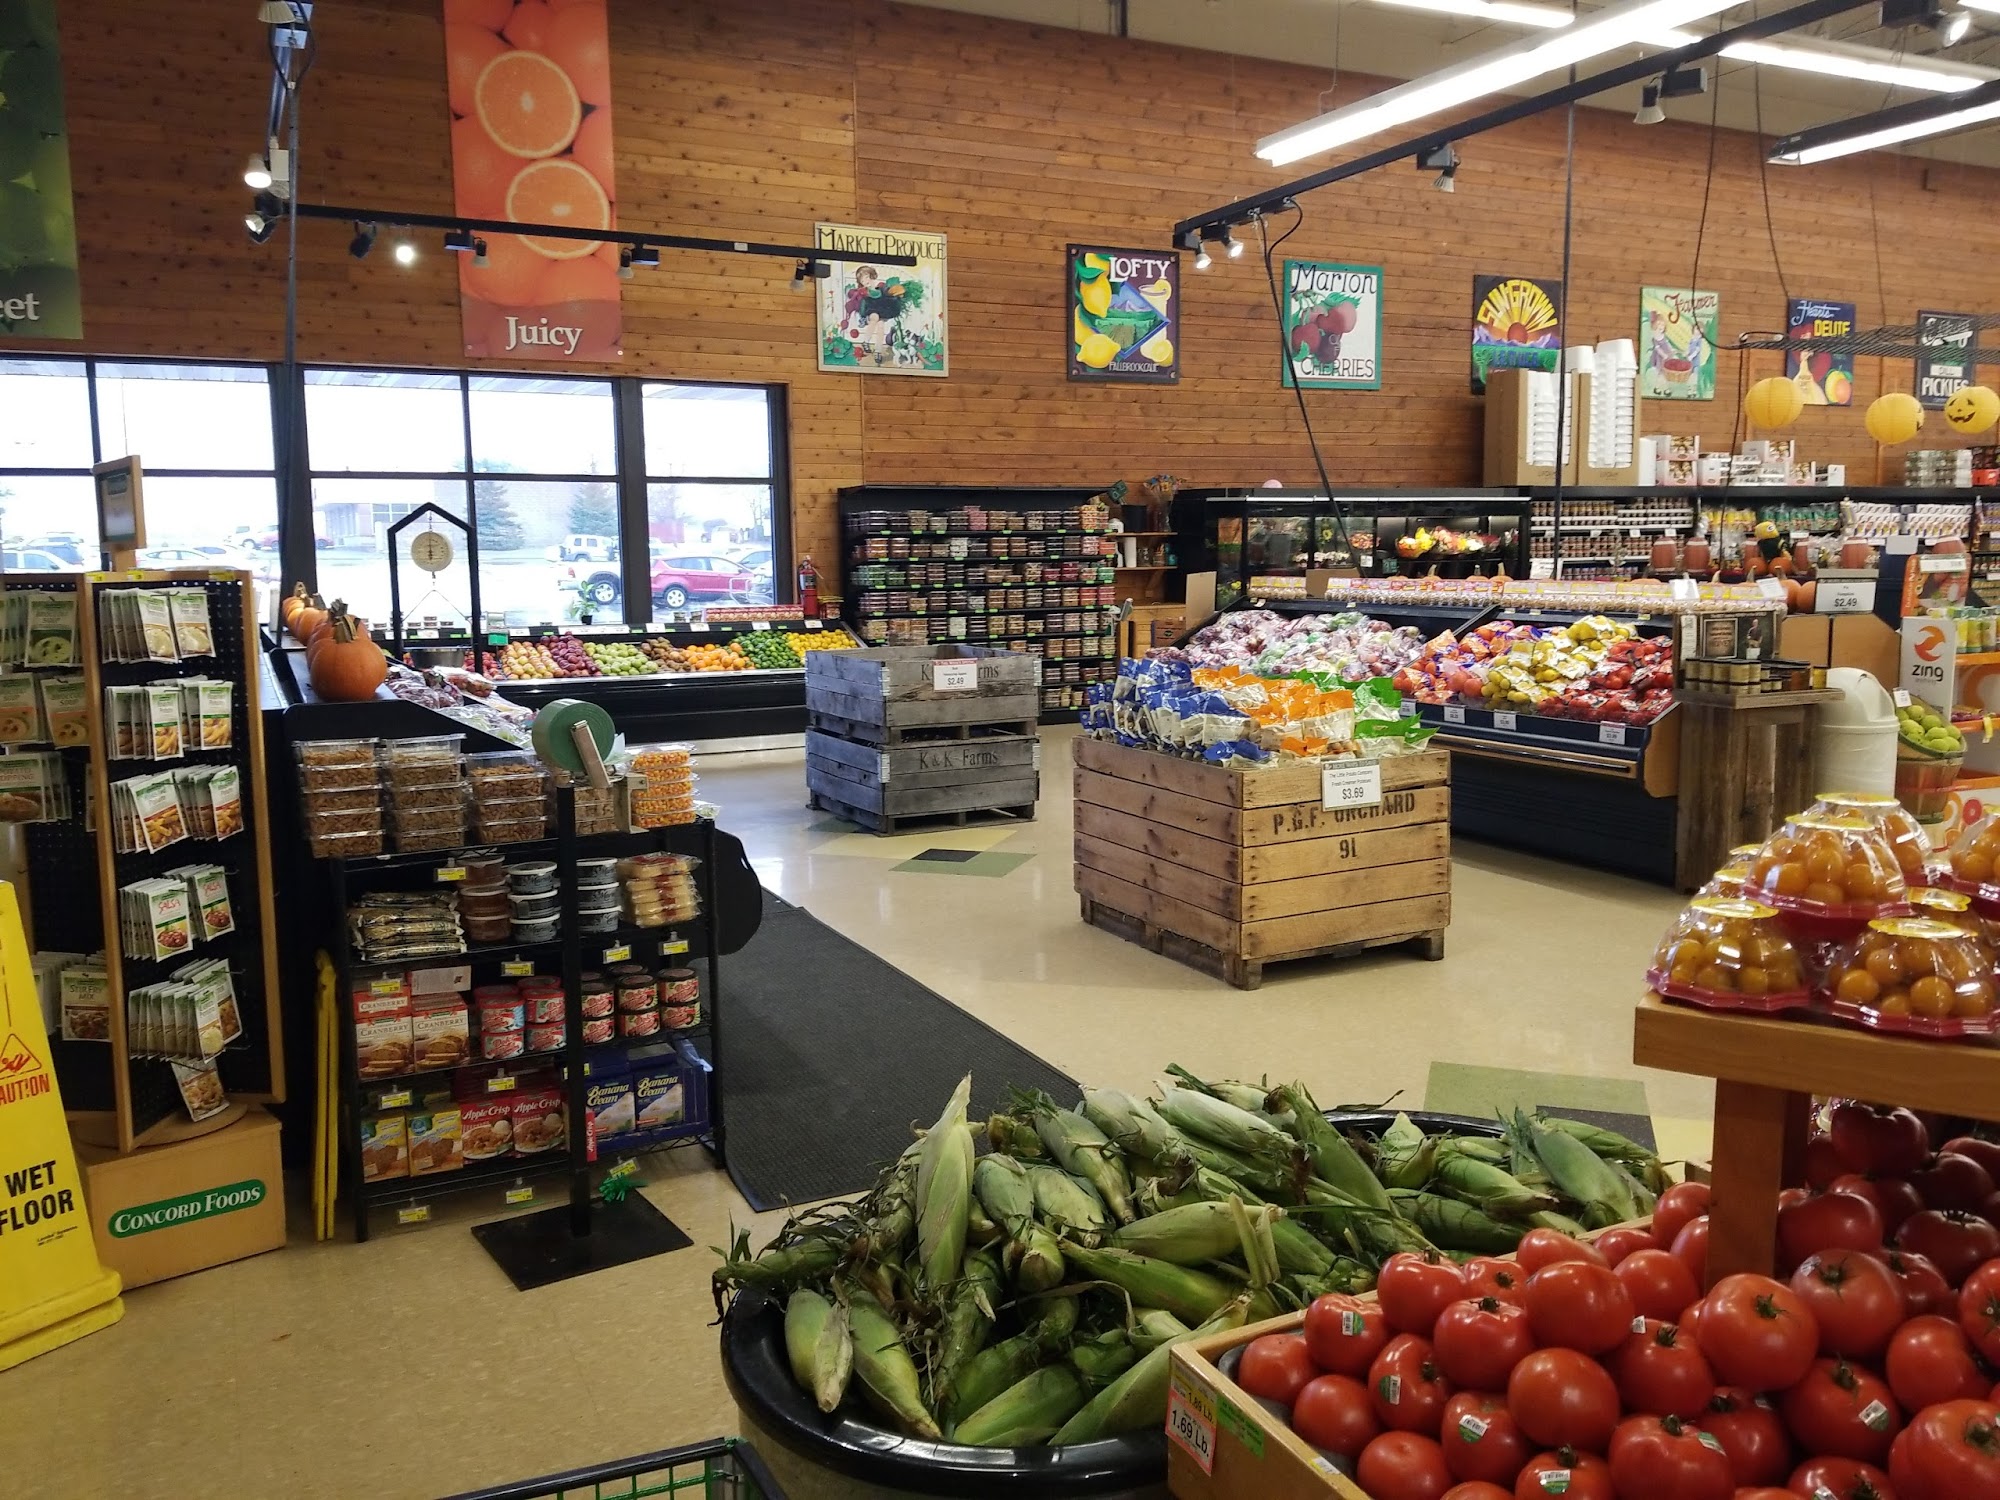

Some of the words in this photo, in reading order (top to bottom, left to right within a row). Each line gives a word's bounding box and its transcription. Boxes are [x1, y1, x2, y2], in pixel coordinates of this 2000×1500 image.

[1108, 256, 1171, 282] LOFTY
[1290, 262, 1377, 294] Marion
[504, 316, 584, 355] Juicy
[1300, 357, 1374, 378] CHERRIES
[1834, 597, 1857, 608] $2.49
[947, 676, 964, 686] $2.49
[1912, 664, 1944, 682] zing
[962, 748, 998, 766] Farms
[1342, 787, 1364, 800] $3.69
[158, 897, 182, 915] SALSA
[360, 999, 406, 1010] CRANBERRY
[360, 1024, 409, 1037] CRANBERRY
[417, 1018, 464, 1030] CRANBERRY
[638, 1076, 679, 1089] Banana
[587, 1084, 630, 1098] Banana
[637, 1086, 668, 1098] Cream
[513, 1102, 539, 1114] Apple
[538, 1098, 561, 1109] Crisp
[587, 1095, 619, 1107] Cream
[462, 1109, 488, 1120] Apple
[487, 1105, 511, 1116] Crisp
[4, 1160, 57, 1198] WET
[0, 1188, 75, 1236] FLOOR
[114, 1201, 201, 1233] CONCORD
[204, 1186, 262, 1213] FOODS
[1172, 1409, 1193, 1439] 1.69
[1195, 1427, 1209, 1458] Lb.
